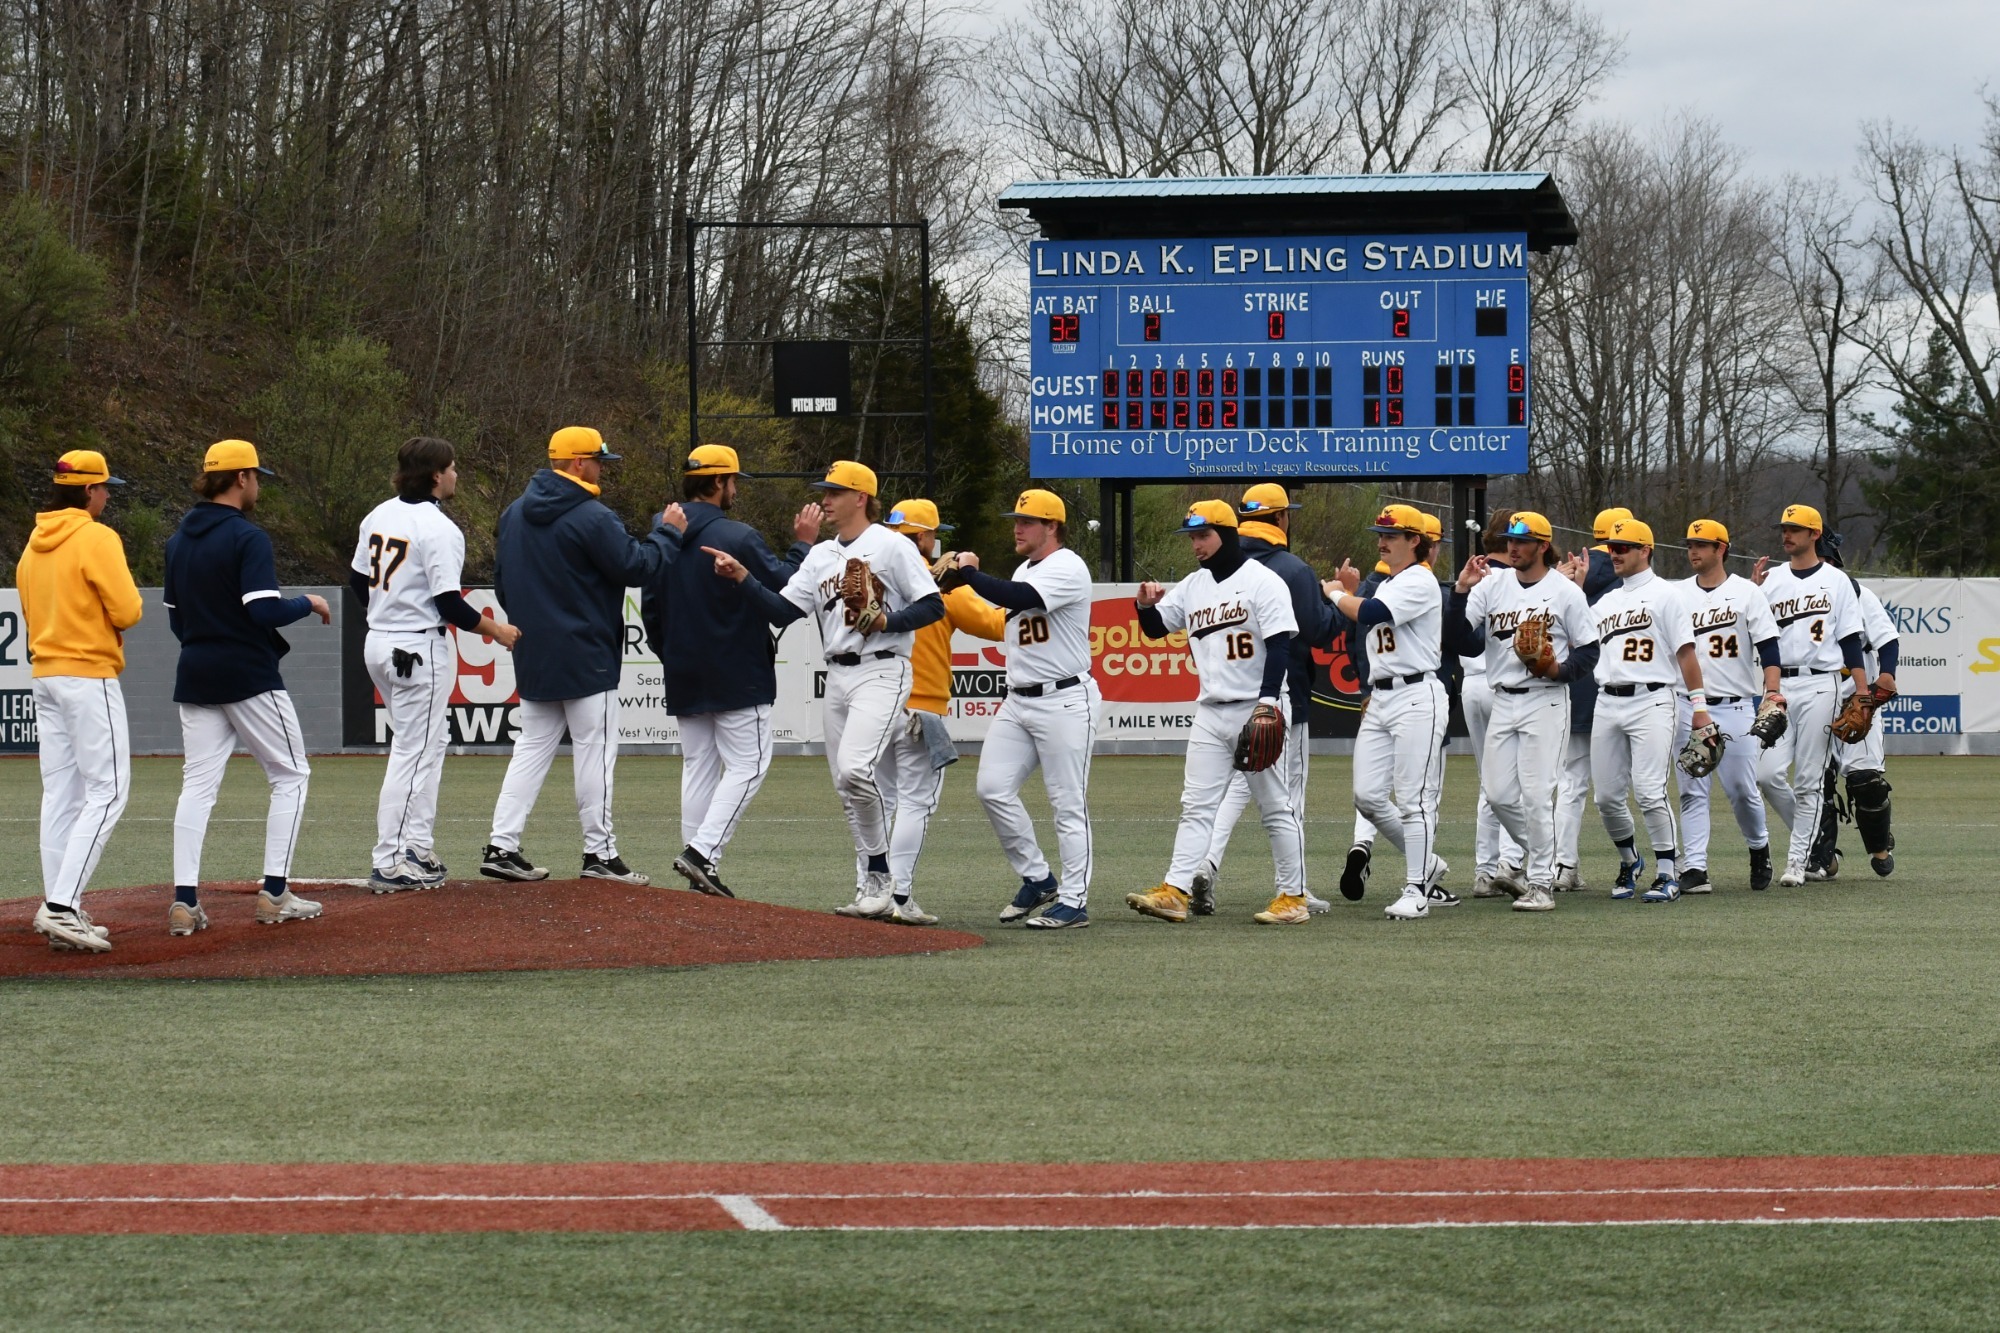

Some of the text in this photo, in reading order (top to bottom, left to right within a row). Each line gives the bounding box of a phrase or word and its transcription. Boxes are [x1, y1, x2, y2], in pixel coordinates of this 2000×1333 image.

[1036, 241, 1524, 277] LINDA K. EPLING STADIUM
[1033, 295, 1098, 315] AT BAT
[1129, 295, 1175, 313] BALL
[1244, 292, 1309, 312] STRIKE
[1380, 290, 1422, 310] OUT
[1476, 289, 1506, 308] H/E
[1052, 315, 1079, 341] 32
[1146, 314, 1159, 340] 2
[1269, 312, 1284, 339] 0
[1394, 311, 1409, 336] 2
[1109, 351, 1330, 368] 1 2 3 4 5 6 7 8 9 10
[1362, 350, 1405, 366] RUNS
[1438, 349, 1475, 365] HITS
[1510, 348, 1519, 364] E
[1031, 376, 1098, 396] GUEST
[1509, 366, 1524, 392] 8
[791, 397, 837, 412] PITCH SPEED
[1034, 404, 1094, 425] HOME
[1050, 428, 1511, 460] Home of Upper Deck Training Center
[1189, 461, 1390, 475] Sponsored by Legacy Resources, LLC
[368, 533, 410, 592] 37
[1218, 600, 1246, 622] Tech
[1708, 605, 1736, 625] Tech
[1803, 594, 1829, 614] Tech
[1624, 607, 1651, 627] Tech
[1896, 606, 1951, 634] RKS
[1018, 615, 1049, 645] 20
[1089, 619, 1189, 656] gole
[1376, 626, 1396, 654] 13
[1810, 619, 1824, 642] 4
[1226, 631, 1254, 660] 16
[1623, 638, 1654, 662] 23
[1709, 634, 1738, 658] 34
[375, 707, 522, 743] NWS
[1108, 715, 1196, 728] 1 MILE WES
